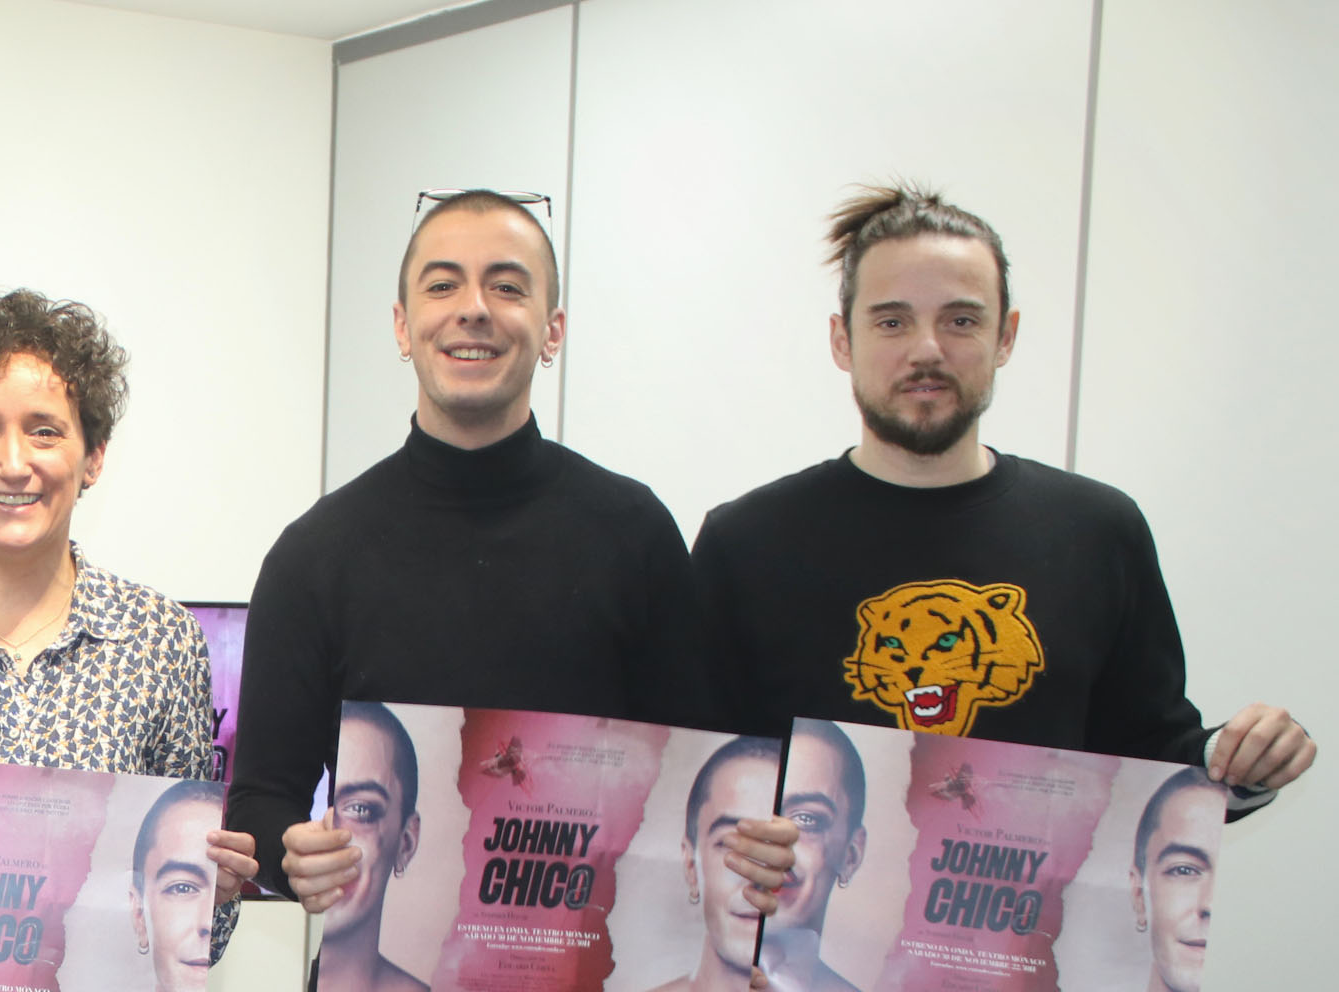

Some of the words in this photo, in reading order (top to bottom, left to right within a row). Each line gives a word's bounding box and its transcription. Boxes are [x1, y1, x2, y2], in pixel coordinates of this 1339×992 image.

[483, 817, 600, 858] JOHNNY
[929, 838, 1048, 884] JOHNNY
[478, 856, 594, 910] CHICO
[923, 877, 1042, 935] CHICO
